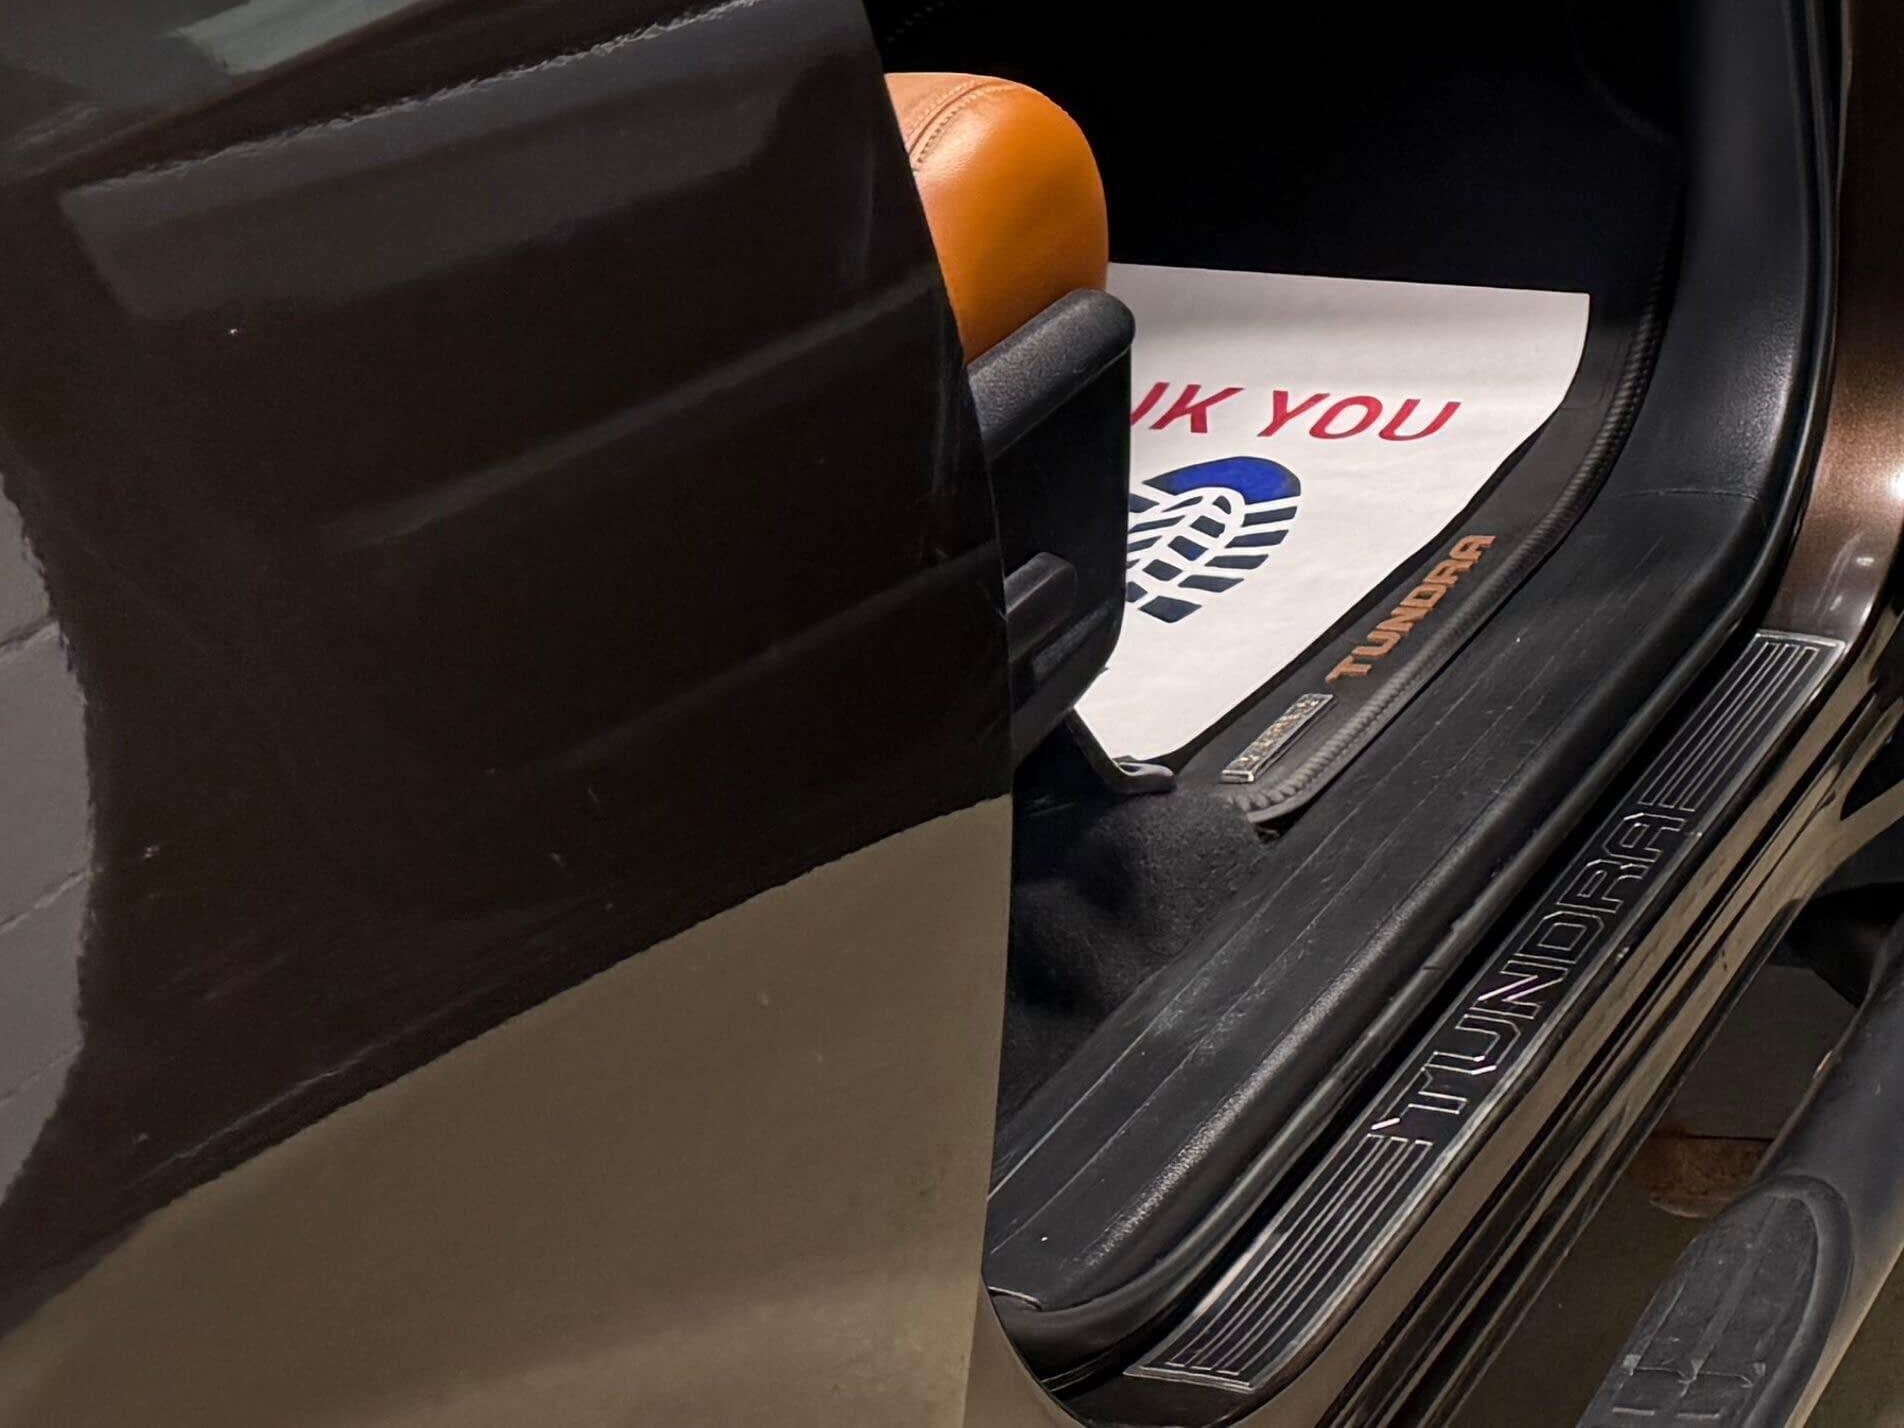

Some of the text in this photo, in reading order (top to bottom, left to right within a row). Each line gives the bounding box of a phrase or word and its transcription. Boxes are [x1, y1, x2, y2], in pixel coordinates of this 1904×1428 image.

[1257, 389, 1462, 442] YOU
[1326, 534, 1497, 683] TUNDRA
[1370, 812, 1687, 1131] TUNDRA
